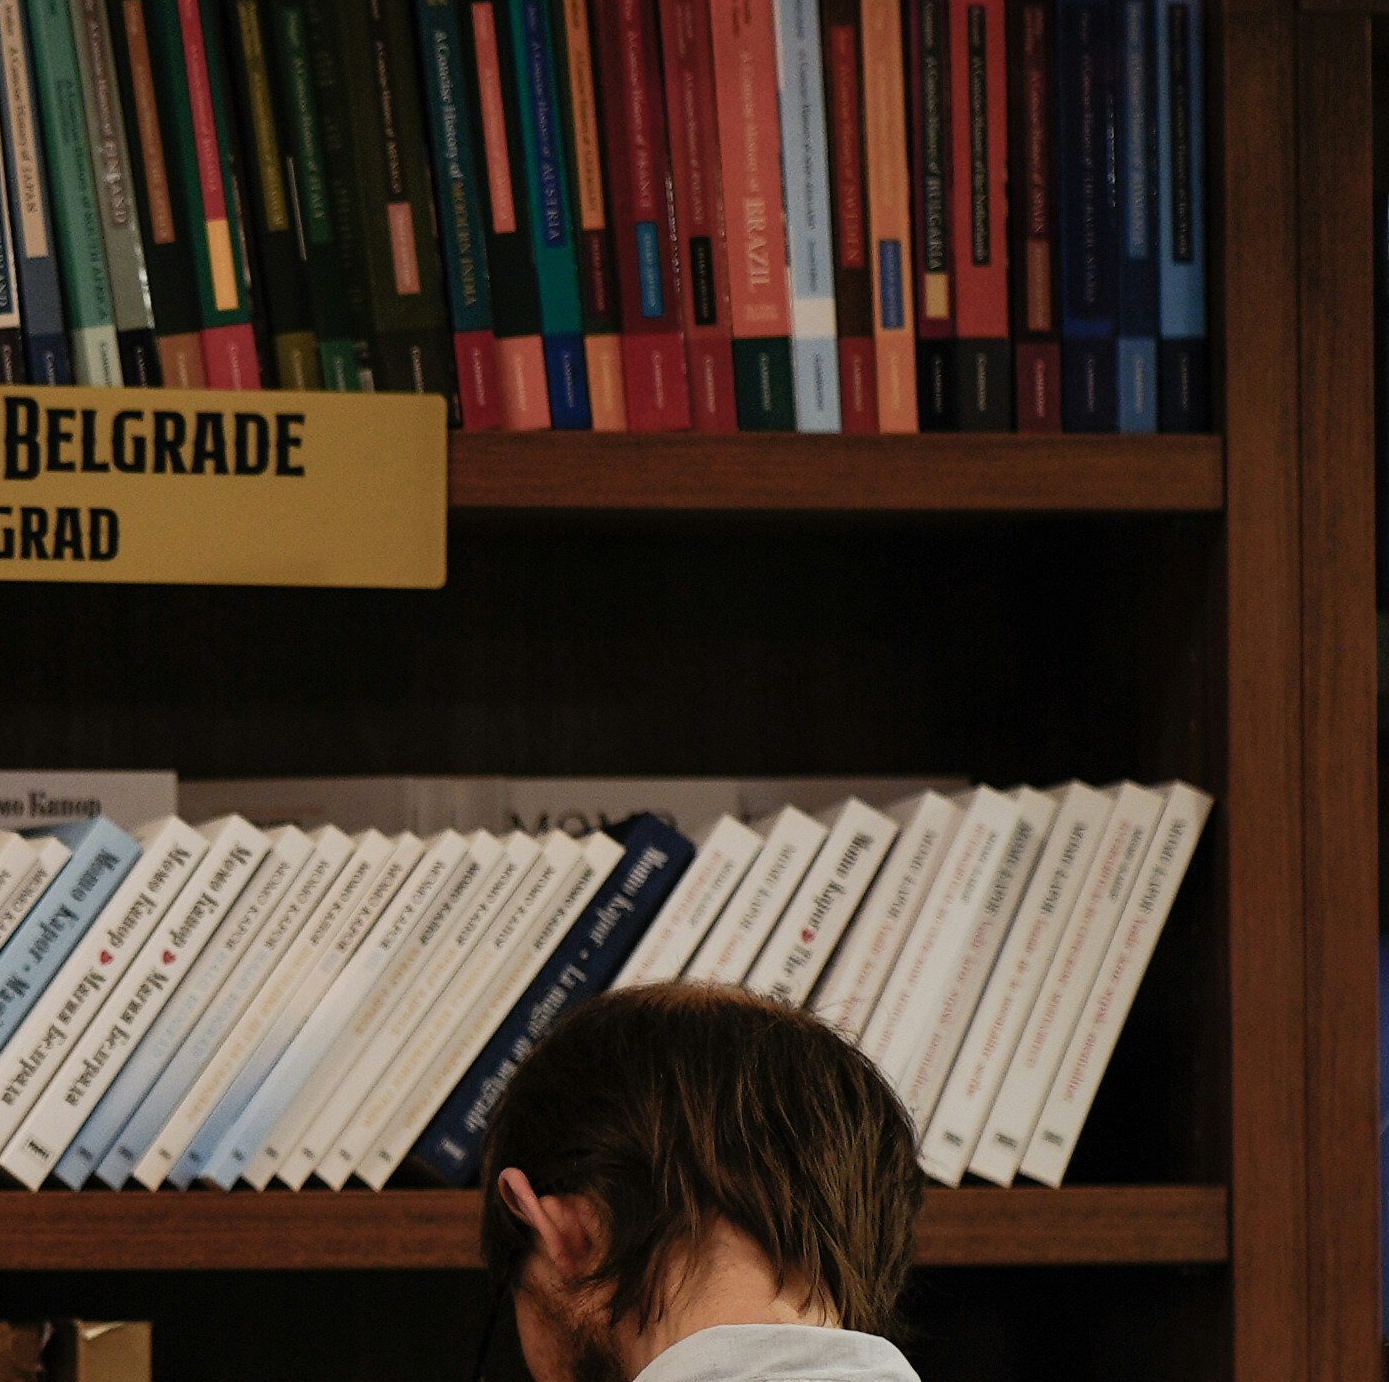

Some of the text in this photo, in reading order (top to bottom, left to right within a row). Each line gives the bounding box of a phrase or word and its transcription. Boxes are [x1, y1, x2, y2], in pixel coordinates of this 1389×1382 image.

[443, 105, 459, 158] History
[541, 163, 560, 241] AUSTRIA
[924, 177, 943, 271] BULGARIA
[744, 200, 770, 294] BRAZIL
[2, 394, 306, 482] BELGRADE
[28, 791, 102, 819] Капор
[67, 846, 121, 908] Momo
[144, 842, 192, 897] Момо
[616, 841, 670, 902] Momo
[21, 899, 80, 965] Kapor
[103, 890, 158, 953] Капор
[55, 966, 107, 1028] Магия
[57, 842, 253, 1109] Момо Капор Магия Белграда
